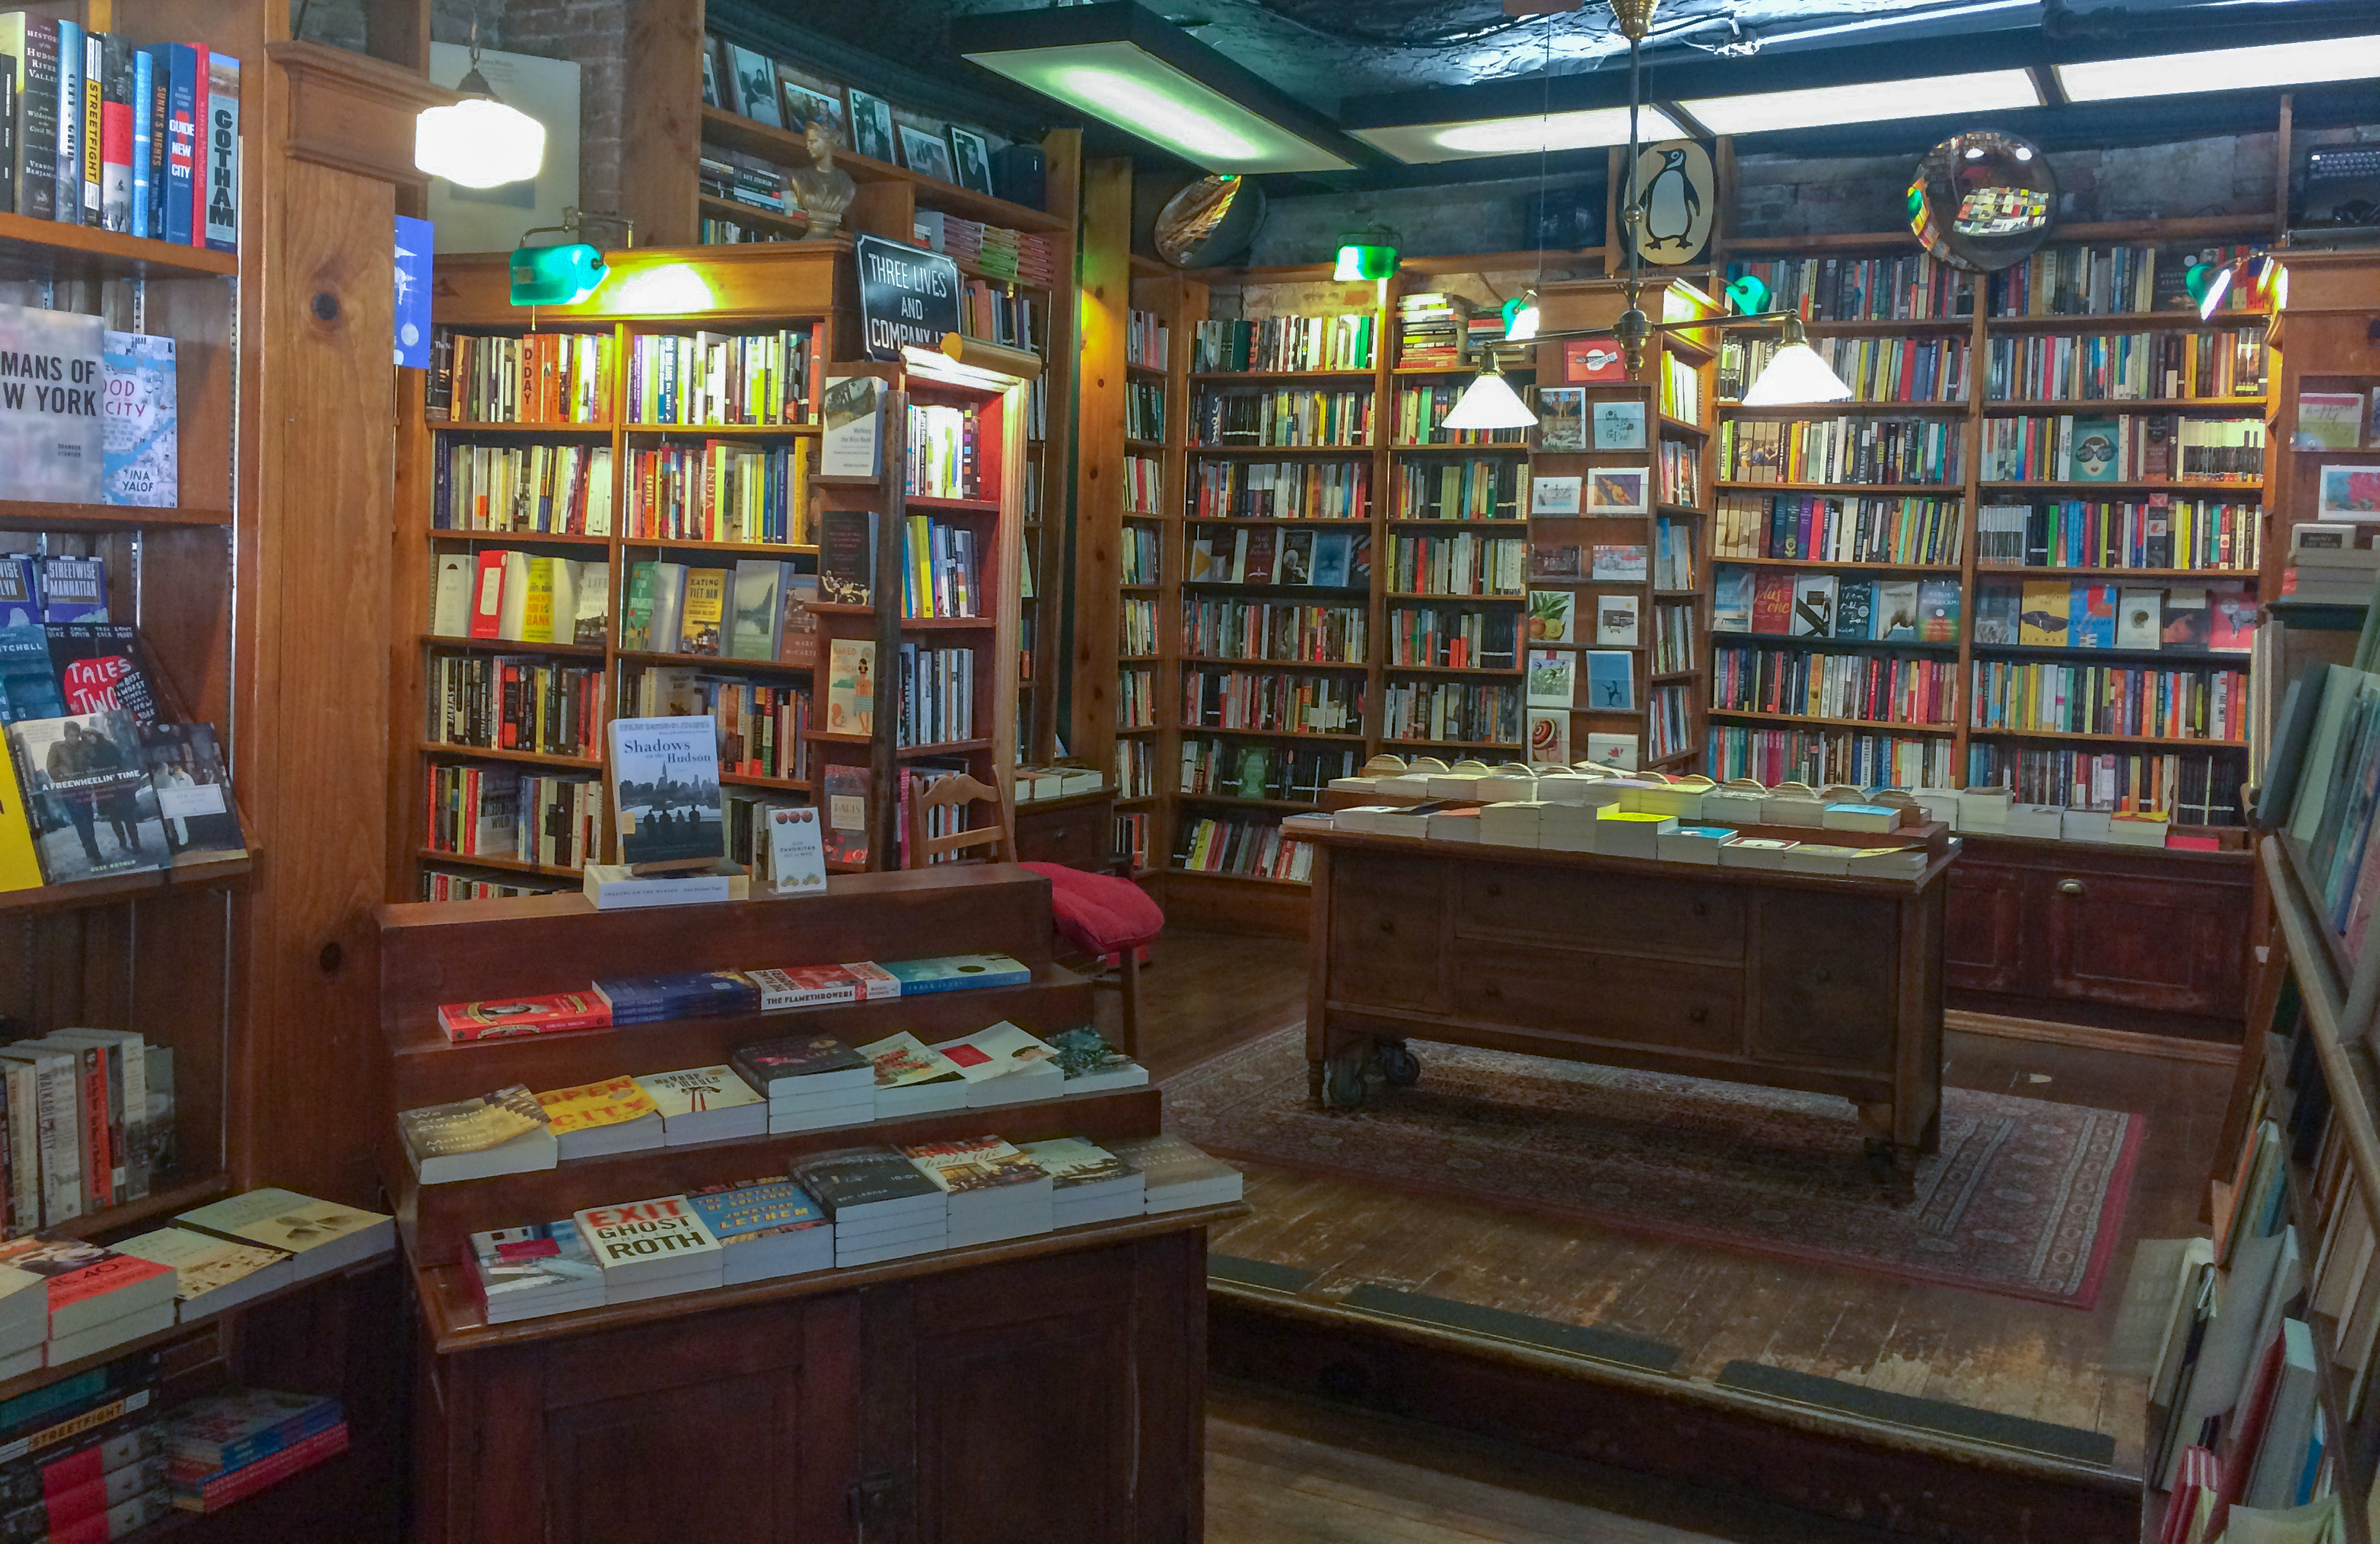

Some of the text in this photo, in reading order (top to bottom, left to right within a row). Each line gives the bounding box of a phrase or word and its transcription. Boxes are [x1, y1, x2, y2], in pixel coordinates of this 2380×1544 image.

[28, 31, 58, 43] HISTOR
[27, 47, 58, 61] HUDSO
[88, 83, 98, 179] STREETFIGHT
[169, 119, 195, 136] GUIDE
[152, 131, 163, 166] NIGHTS
[171, 141, 192, 158] NEW
[171, 163, 190, 179] CITY
[209, 109, 234, 228] GOTHAM
[868, 253, 947, 298] THREE LIVES
[901, 296, 923, 321] AND
[871, 318, 930, 351] COMPANY
[1, 351, 96, 384] MANS OF
[35, 385, 97, 416] YORK
[105, 401, 147, 417] CITY
[129, 470, 150, 481] INA
[122, 481, 154, 492] YALOF
[706, 467, 715, 509] INDIA
[49, 562, 96, 579] STREETWISE
[50, 580, 97, 597] MANHATTAN
[690, 588, 704, 598] VIET
[1753, 583, 1781, 604] plus
[1767, 602, 1791, 614] one
[526, 615, 550, 626] BANK
[67, 658, 132, 684] TALES
[831, 665, 858, 673] LUNCH
[124, 672, 141, 685] BEST
[121, 680, 145, 695] WORST
[74, 686, 121, 715] TWO
[133, 700, 152, 711] NEW
[138, 708, 155, 720] YORK
[624, 738, 691, 753] Shadows
[667, 752, 711, 764] Hudson
[42, 783, 49, 791] A
[50, 774, 116, 790] FREEWHEELIN'
[117, 769, 141, 780] TIME
[834, 804, 860, 814] PARIS
[491, 815, 510, 829] WILD
[784, 990, 853, 1004] FLAMETHROWERS
[39, 1072, 53, 1124] WALKABLE
[537, 1079, 631, 1106] OPEN
[452, 1109, 483, 1119] Not
[552, 1098, 644, 1126] CITY
[891, 1173, 919, 1182] 10:04
[729, 1191, 793, 1206] SOLITUDE
[586, 1198, 680, 1228] EXIT
[719, 1207, 809, 1229] LETHEM
[724, 1202, 793, 1219] JONATHAN
[596, 1215, 690, 1238] GHOST
[606, 1231, 706, 1260] ROTH
[29, 1405, 123, 1448] STREETFIGHT
